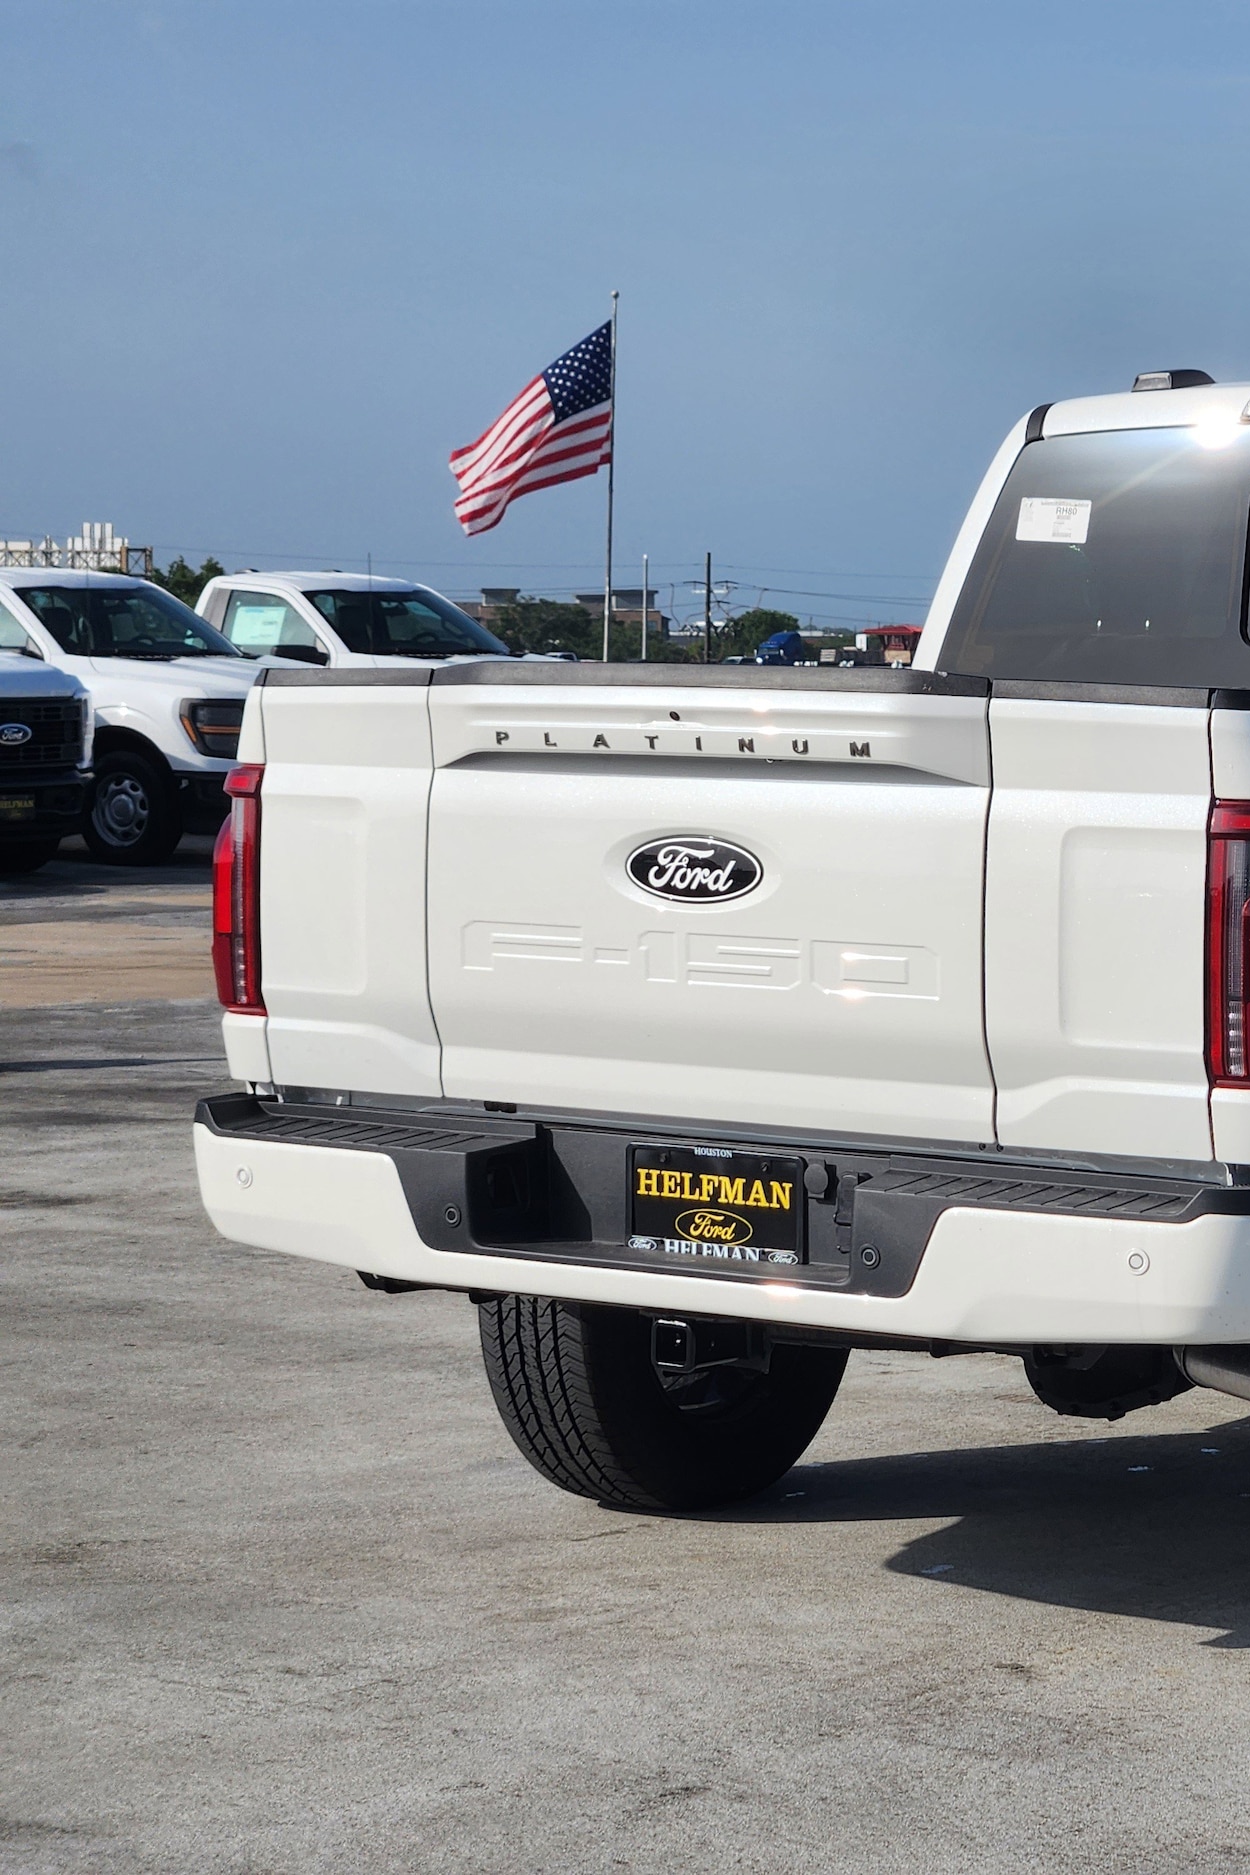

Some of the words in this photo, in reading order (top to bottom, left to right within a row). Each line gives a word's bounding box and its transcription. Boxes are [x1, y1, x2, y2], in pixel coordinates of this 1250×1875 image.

[2, 728, 24, 741] Ford
[495, 731, 872, 758] PLATINUM
[648, 845, 735, 893] Ford
[461, 919, 941, 1000] F-150
[694, 1146, 733, 1158] HOUSTON
[636, 1168, 793, 1210] HELFMAN
[689, 1212, 736, 1241] Ford
